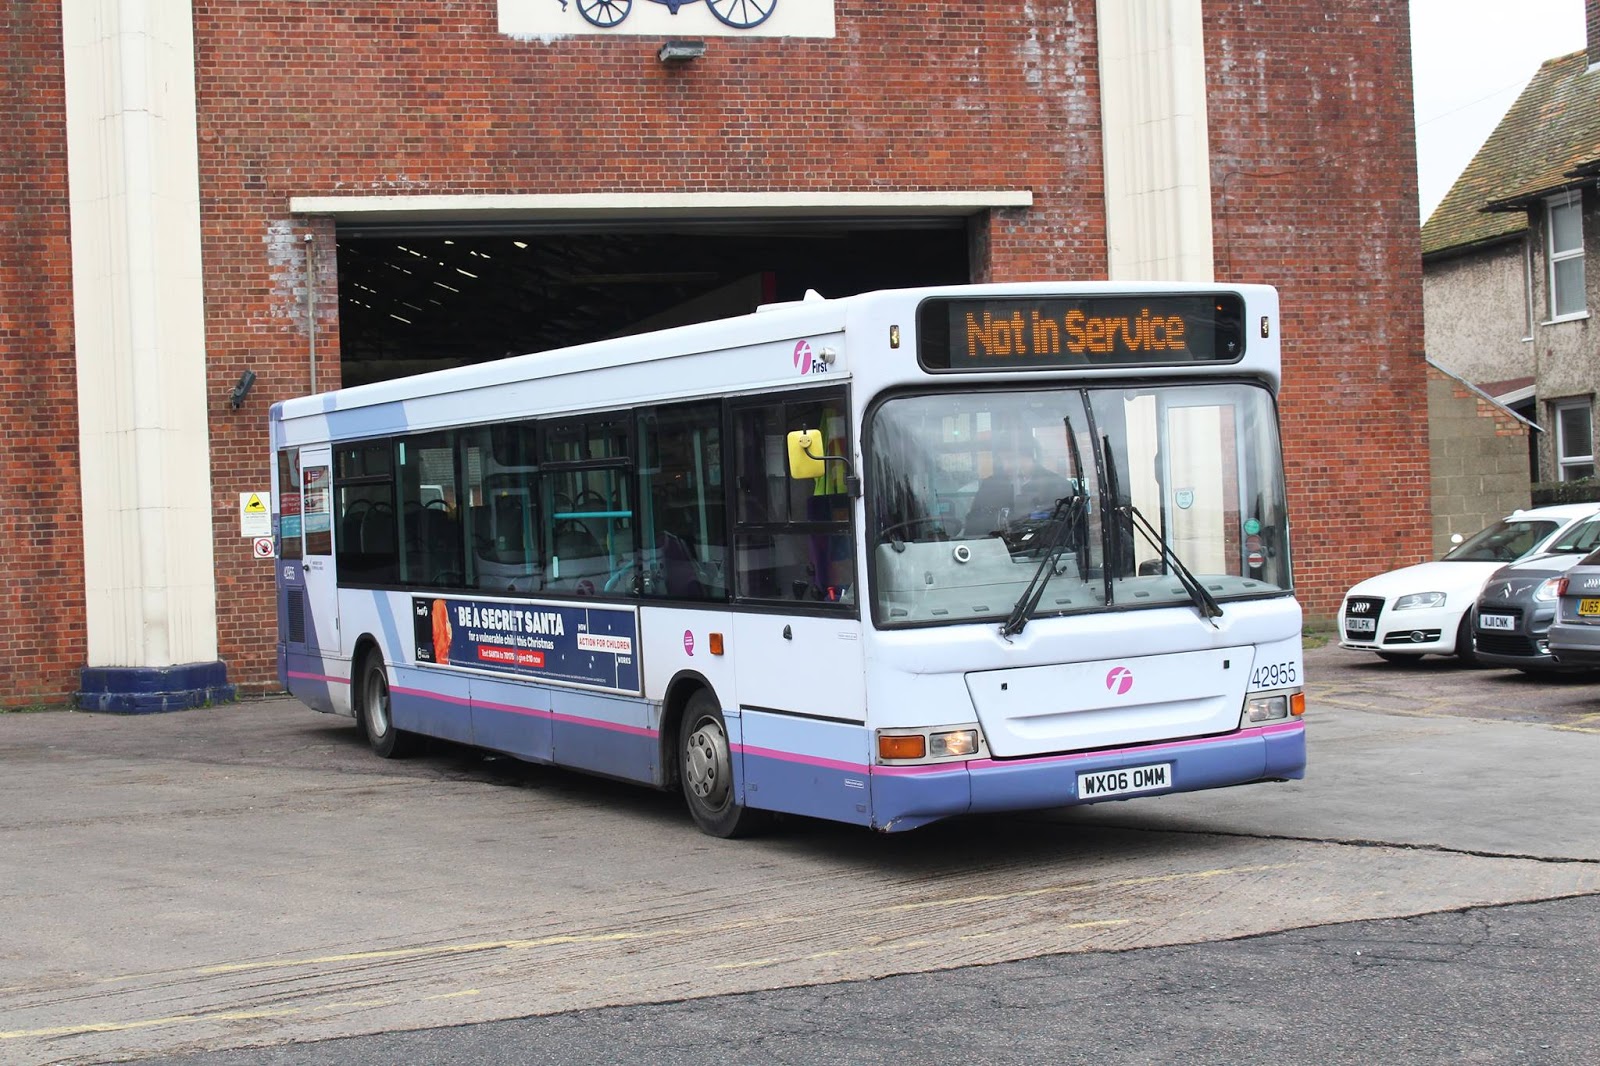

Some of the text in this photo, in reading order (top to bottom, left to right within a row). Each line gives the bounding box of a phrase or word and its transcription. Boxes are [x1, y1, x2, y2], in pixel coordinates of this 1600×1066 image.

[966, 308, 1186, 356] Not in Service
[812, 359, 828, 374] First
[458, 606, 564, 637] BE A SECRET SANTA
[479, 632, 504, 644] vulnerable
[516, 635, 527, 647] this
[527, 636, 555, 650] Christmas
[579, 638, 630, 650] ACTION FOR CHILDREN
[1252, 661, 1296, 689] 42955
[1085, 768, 1165, 794] WX06 OMM
